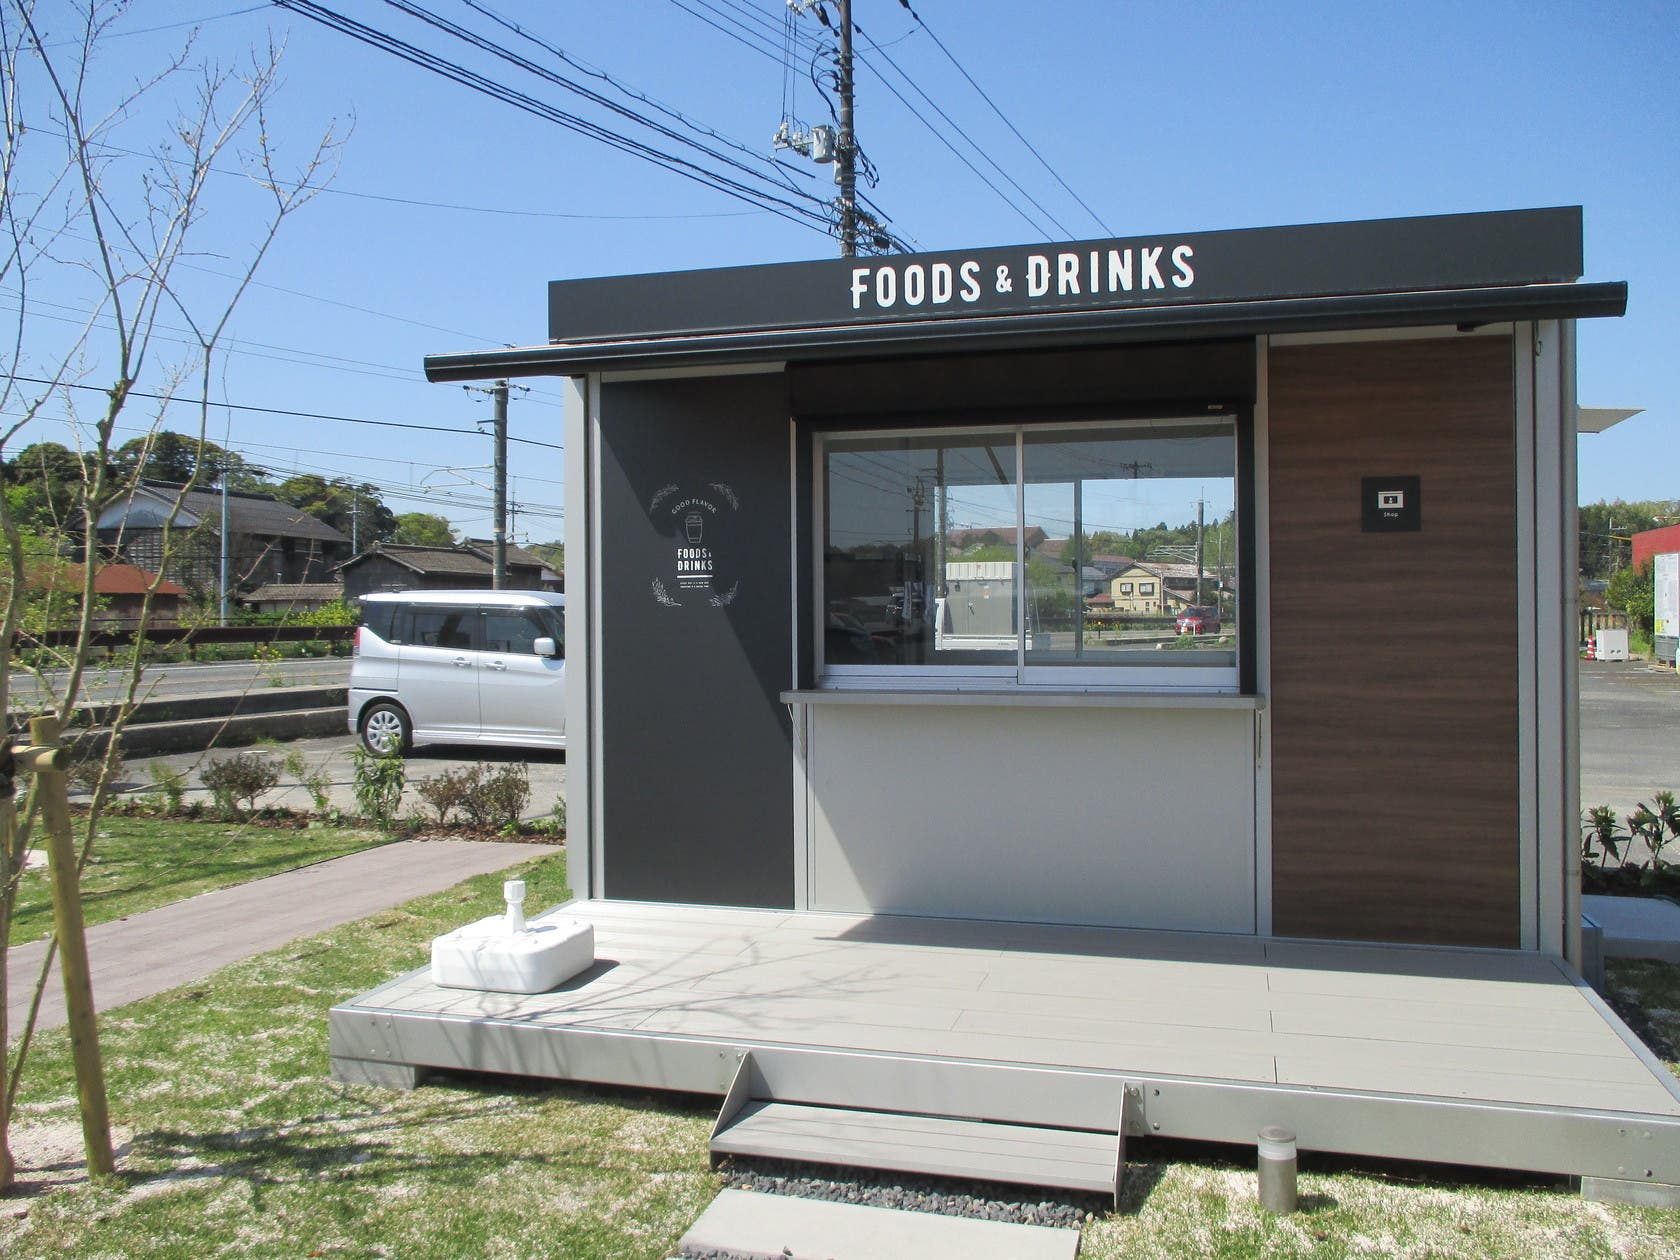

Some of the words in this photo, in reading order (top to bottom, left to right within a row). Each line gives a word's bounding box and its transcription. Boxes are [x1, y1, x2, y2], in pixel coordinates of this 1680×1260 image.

[851, 261, 981, 309] FOODS
[995, 265, 1012, 293] &
[1026, 245, 1195, 297] DRINKS
[671, 499, 690, 514] GOOD
[677, 548, 707, 559] FOODS
[677, 560, 713, 571] DRINKS
